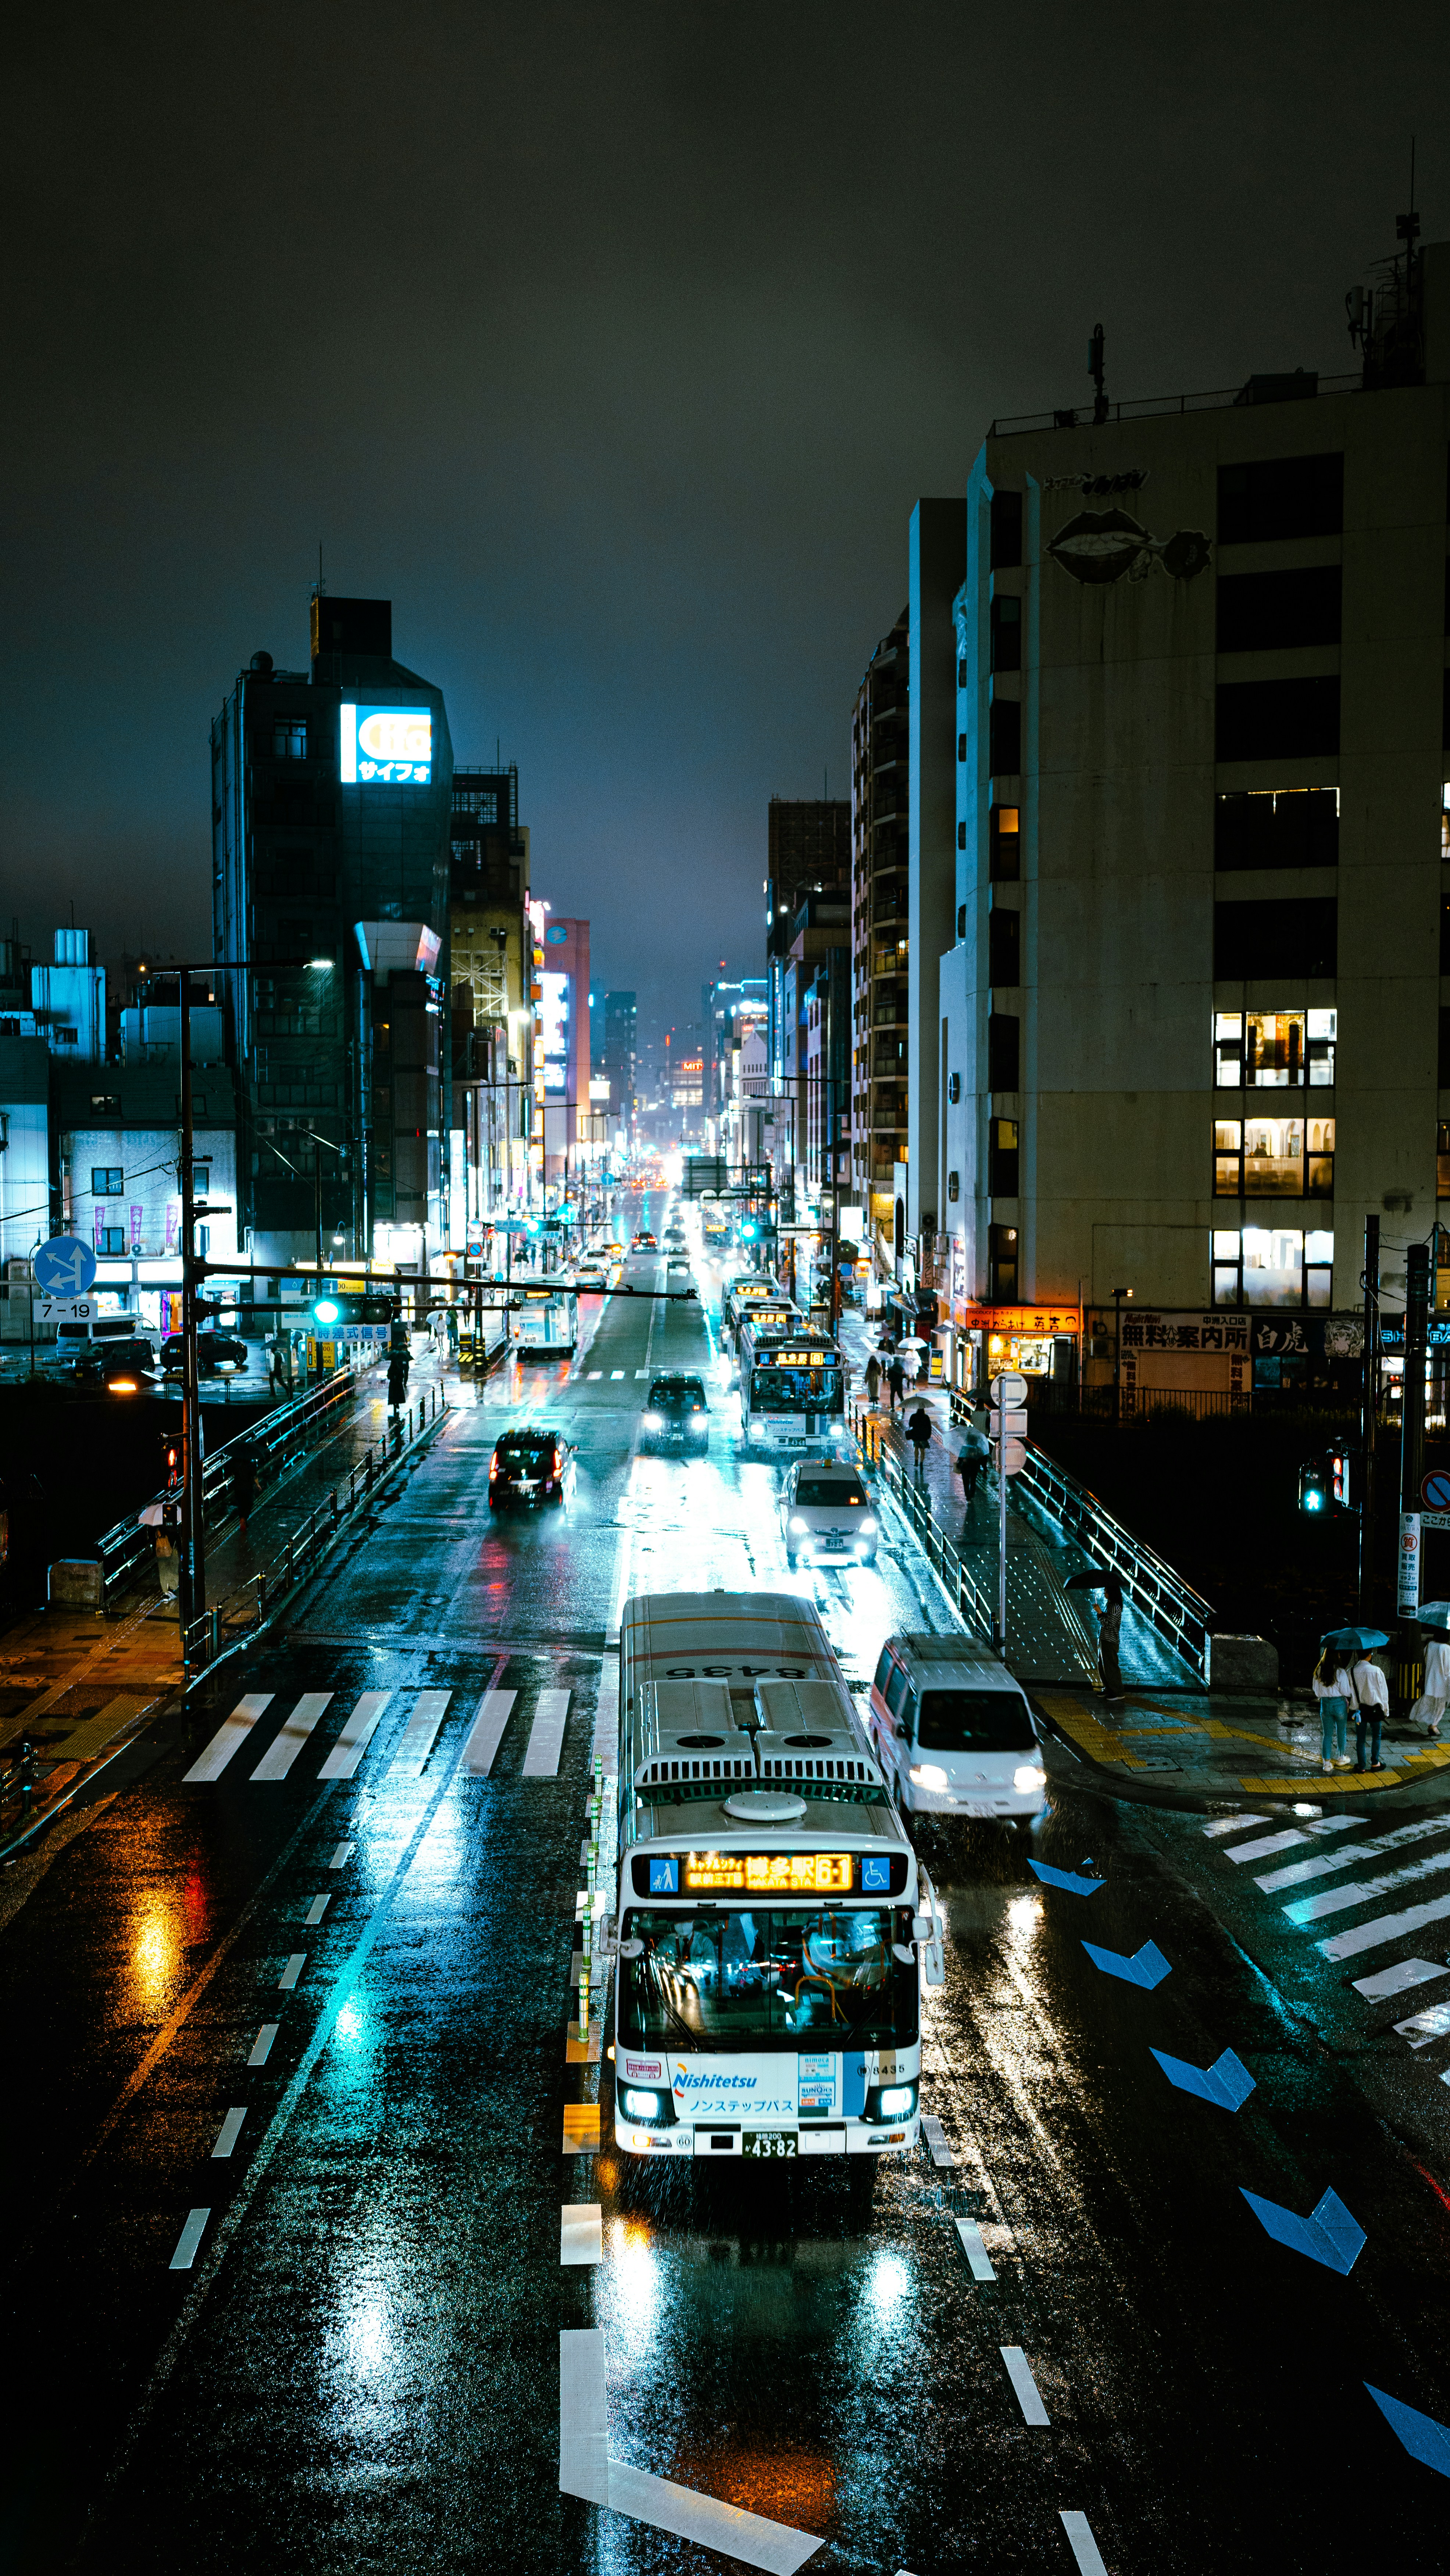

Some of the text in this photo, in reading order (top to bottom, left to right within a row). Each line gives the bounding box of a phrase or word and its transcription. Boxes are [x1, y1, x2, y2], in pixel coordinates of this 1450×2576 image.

[359, 761, 429, 782] サイフォ
[1035, 1316, 1060, 1330] 英吉
[1203, 1316, 1246, 1325] 中洲入口店
[318, 1326, 388, 1339] 時差式信号
[1123, 1324, 1247, 1349] 無料案内所
[1257, 1320, 1310, 1353] 白虎
[1404, 1536, 1414, 1548] 質
[1401, 1553, 1415, 1561] 買取
[666, 1666, 806, 1680] 8435
[746, 1857, 814, 1878] 博多駅
[749, 1878, 786, 1886] HAKATA
[873, 2064, 904, 2075] 8435
[673, 2074, 757, 2087] Nishitetsu
[690, 2100, 793, 2112] ノンステップバス
[752, 2139, 796, 2157] 43-82
